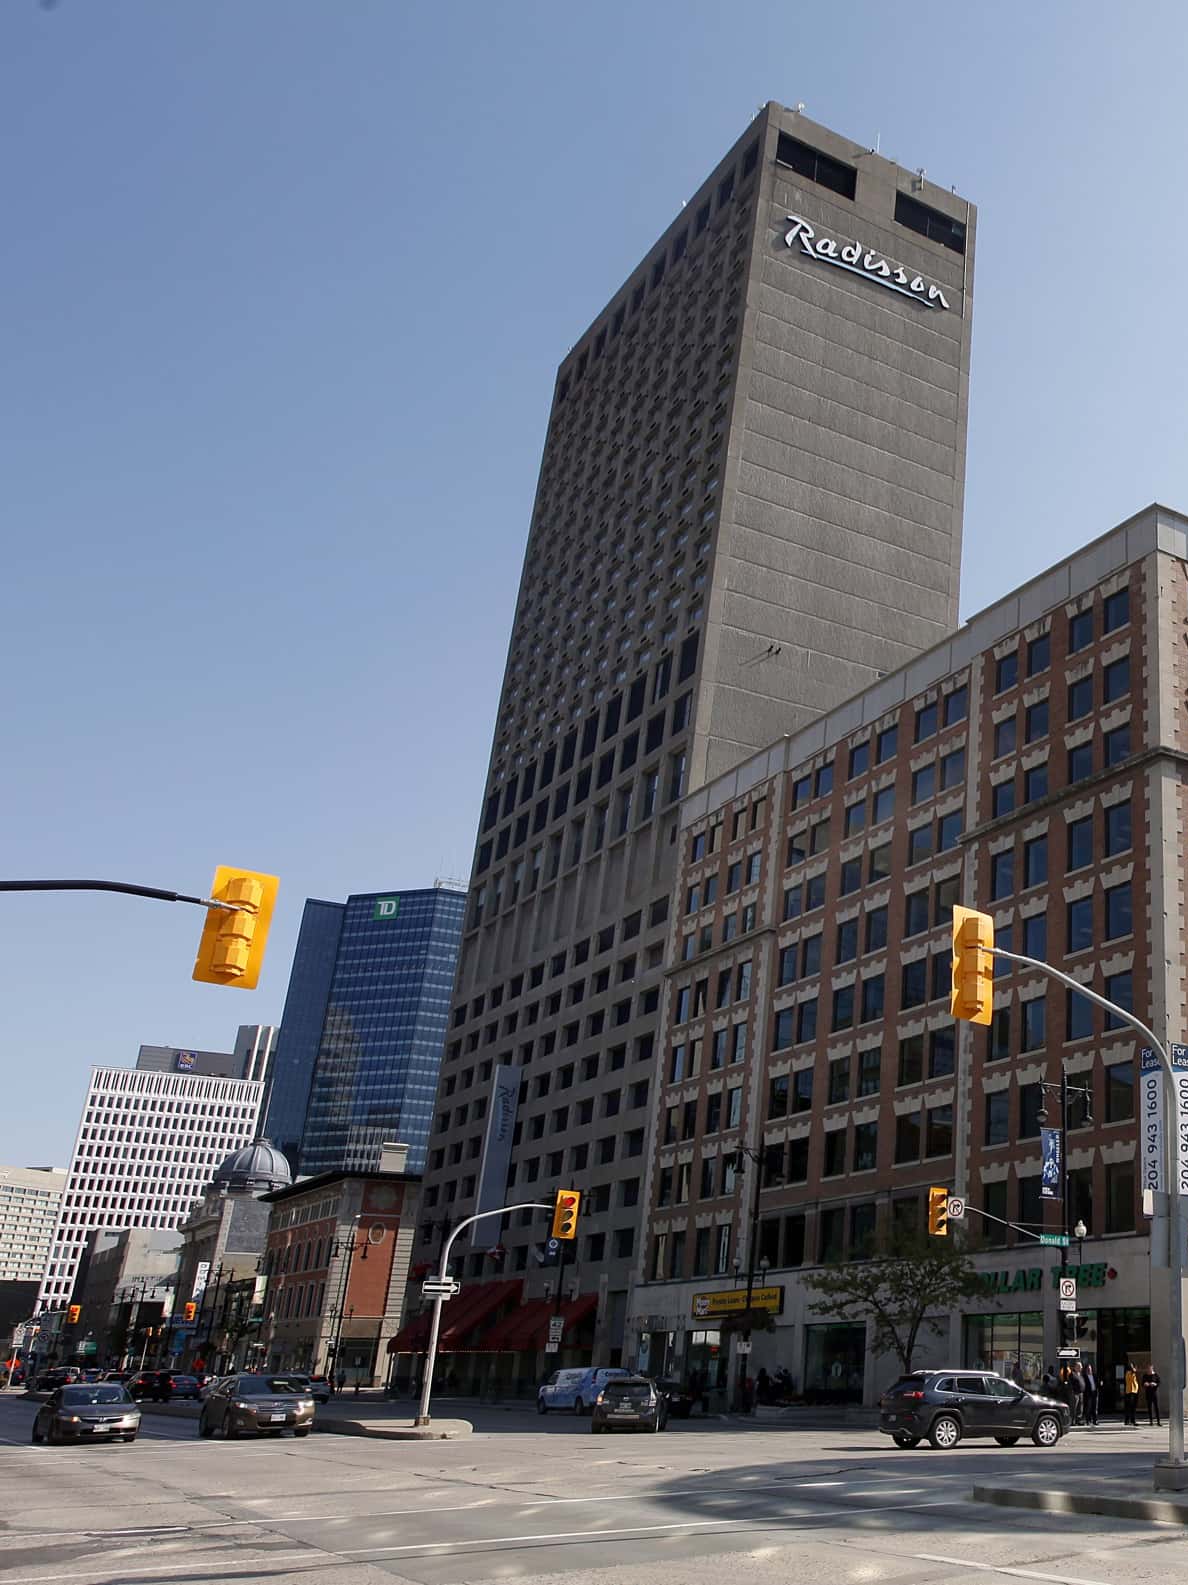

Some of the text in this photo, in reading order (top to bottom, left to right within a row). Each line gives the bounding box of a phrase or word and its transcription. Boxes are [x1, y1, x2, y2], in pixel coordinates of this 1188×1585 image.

[784, 214, 950, 309] Radisson
[376, 901, 396, 915] TD
[1171, 1044, 1186, 1056] For
[1147, 1079, 1158, 1190] 204 943 1600
[1040, 1234, 1060, 1246] Donald
